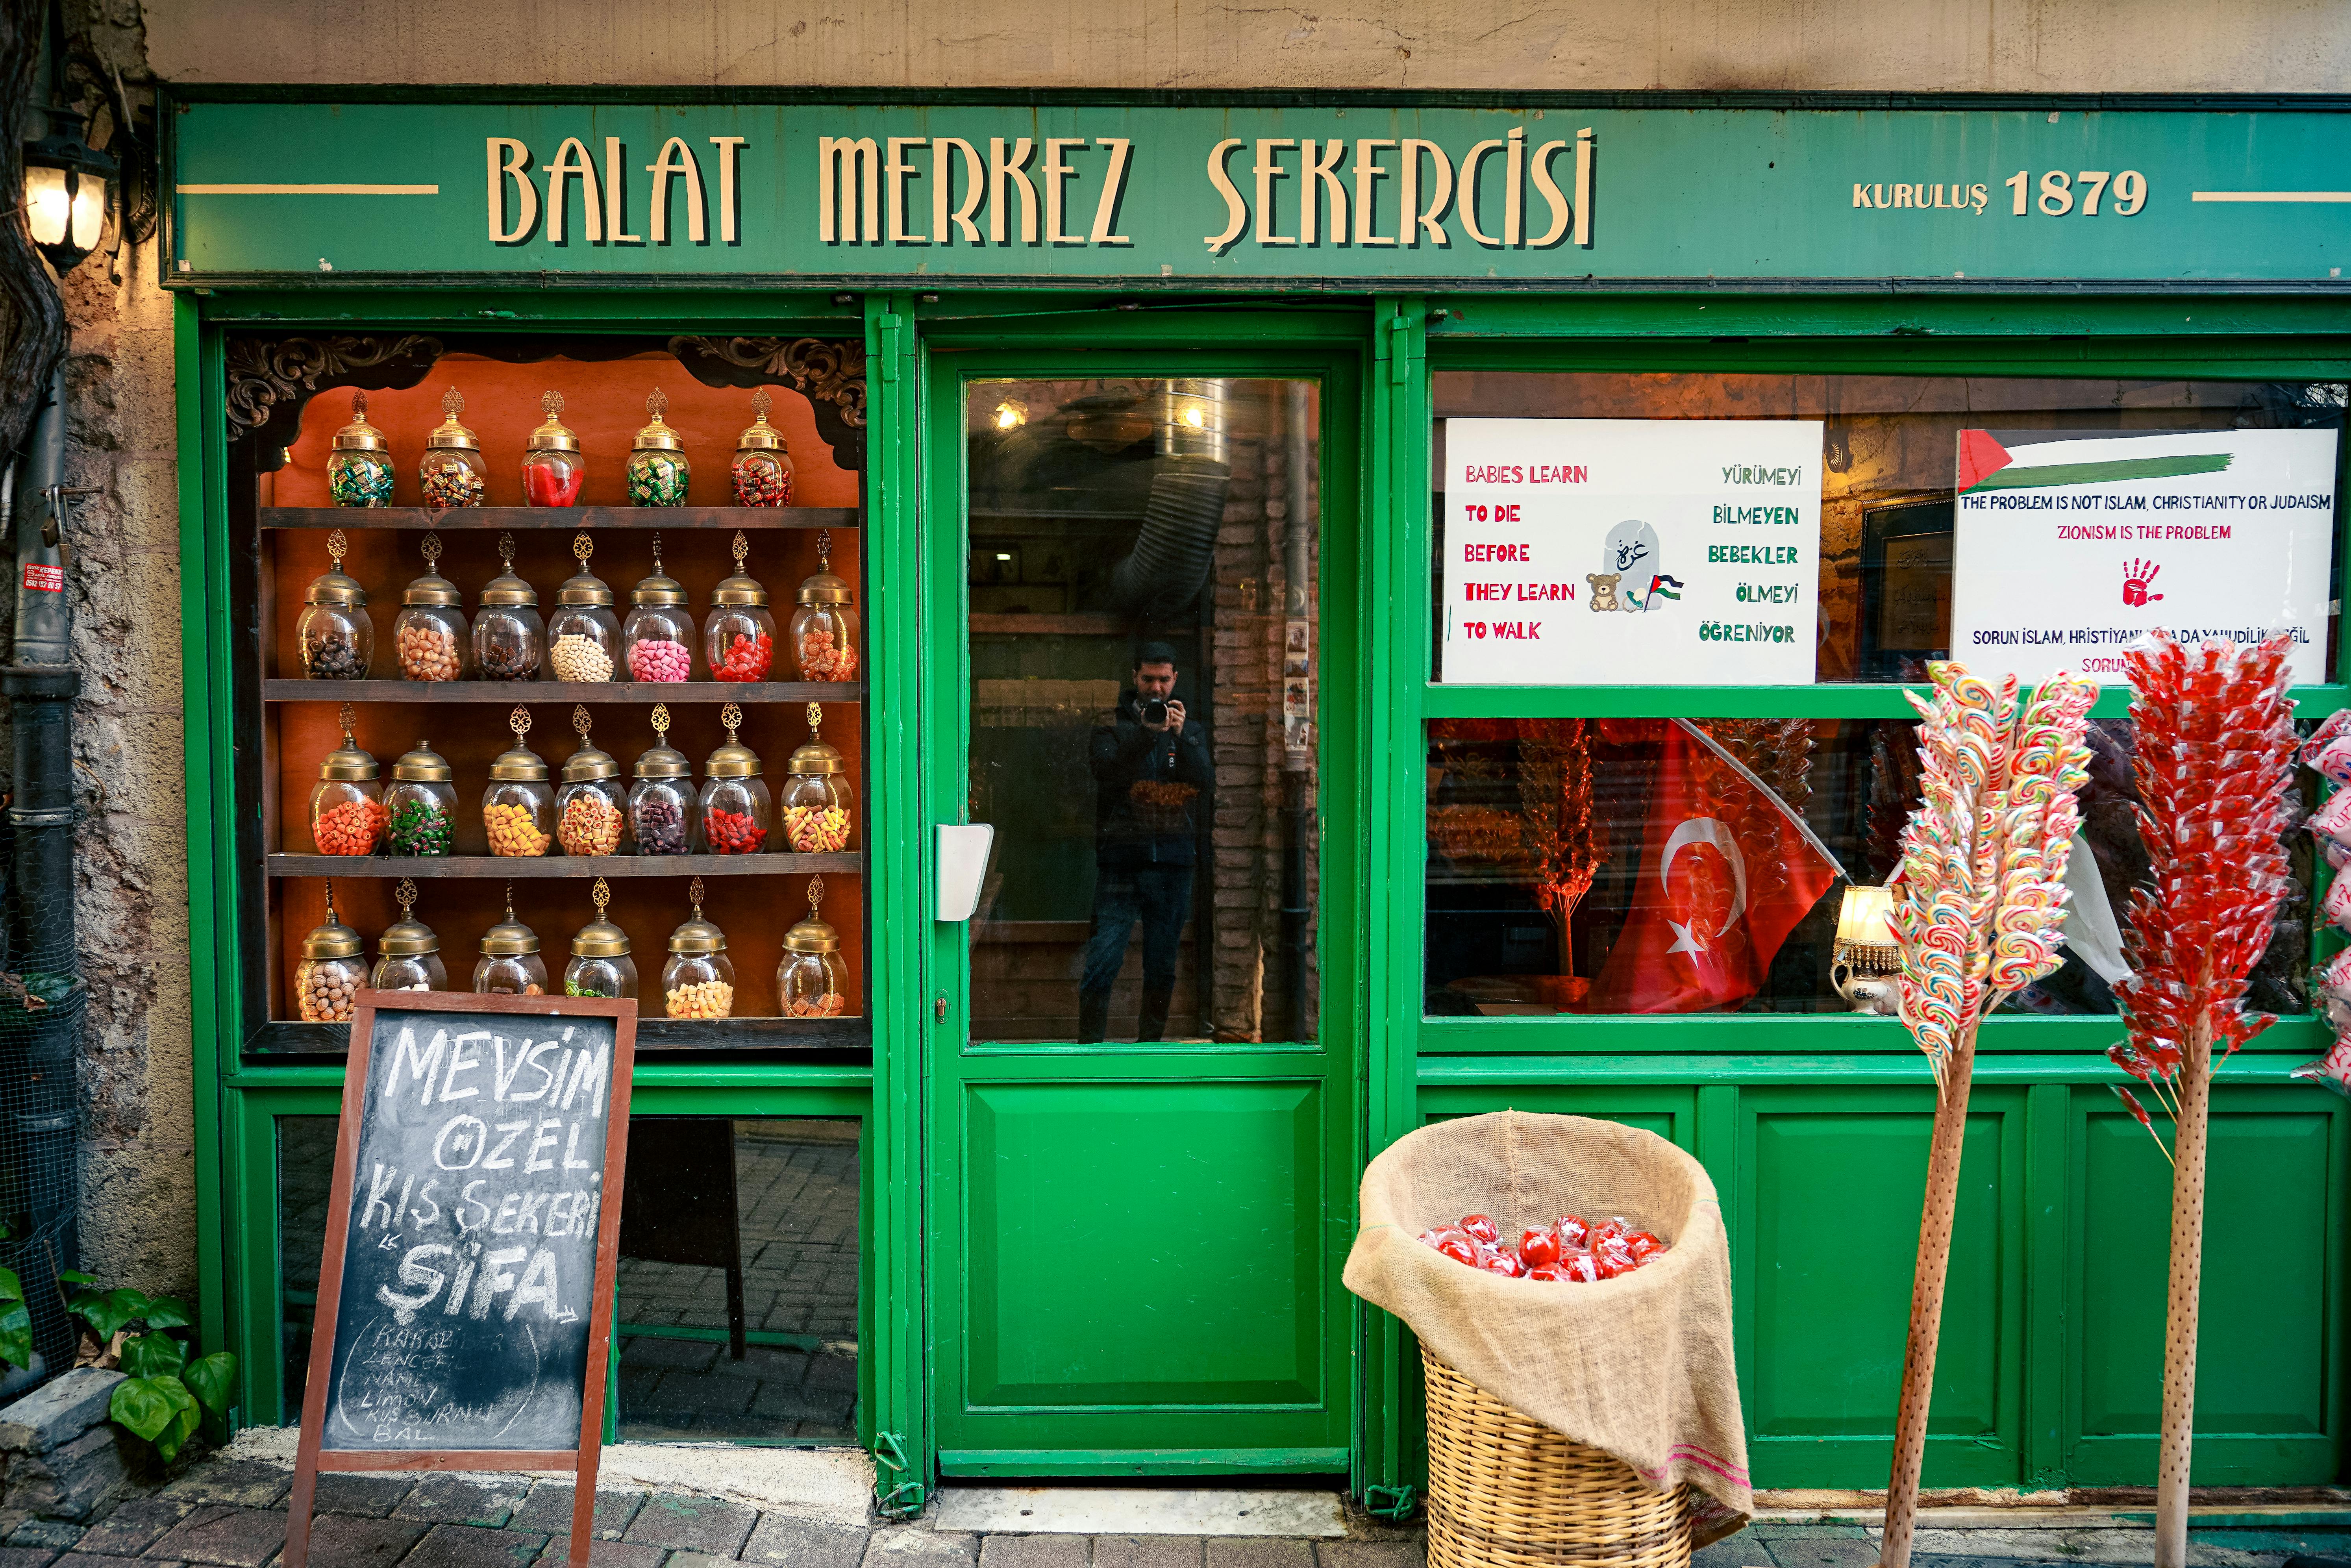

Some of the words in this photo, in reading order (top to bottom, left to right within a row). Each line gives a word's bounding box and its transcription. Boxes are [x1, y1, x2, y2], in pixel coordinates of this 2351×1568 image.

[487, 136, 744, 241] BALAT
[820, 136, 1131, 243] MERKEZ
[1204, 126, 1592, 252] ŞEKERCİSİ
[1853, 183, 1988, 215] KURULUŞ
[2005, 170, 2148, 217] 1879
[1466, 465, 1523, 484] BABIES
[1530, 465, 1587, 483] LEARN
[1722, 464, 1801, 486] YÜRÜMEYİ
[1961, 496, 1986, 509] THE
[1991, 496, 2053, 509] PROBLEM
[2057, 496, 2068, 509] IS
[2071, 495, 2102, 509] NOT
[2105, 496, 2148, 512] ISLAM,
[2153, 496, 2247, 509] CHRISTIANITY
[2248, 496, 2267, 509] OR
[2270, 494, 2331, 509] JUDAISM
[1466, 505, 1487, 522] TO
[1495, 505, 1520, 522] DIE
[1713, 503, 1799, 524] BİLMEYEN
[2058, 526, 2116, 539] ZIONISM
[2121, 526, 2133, 539] IS
[2137, 526, 2162, 539] THE
[2166, 526, 2231, 539] PROBLEM
[1464, 544, 1530, 562] BEFORE
[1709, 545, 1798, 564] BEBEKLER
[1464, 583, 1512, 601] THEY
[1518, 583, 1575, 601] LEARN
[1736, 582, 1798, 603] ÖLMEYİ
[1464, 622, 1486, 639] TO
[1492, 622, 1542, 639] WALK
[1699, 620, 1795, 643] ÖĞRENİYOR
[1973, 630, 2019, 644] SORUN
[2023, 628, 2066, 645] İSLAM,
[2181, 629, 2200, 643] DA
[2286, 626, 2310, 643] ĞİL
[384, 1026, 611, 1119] MEVSİM
[372, 1424, 435, 1442] BAL
